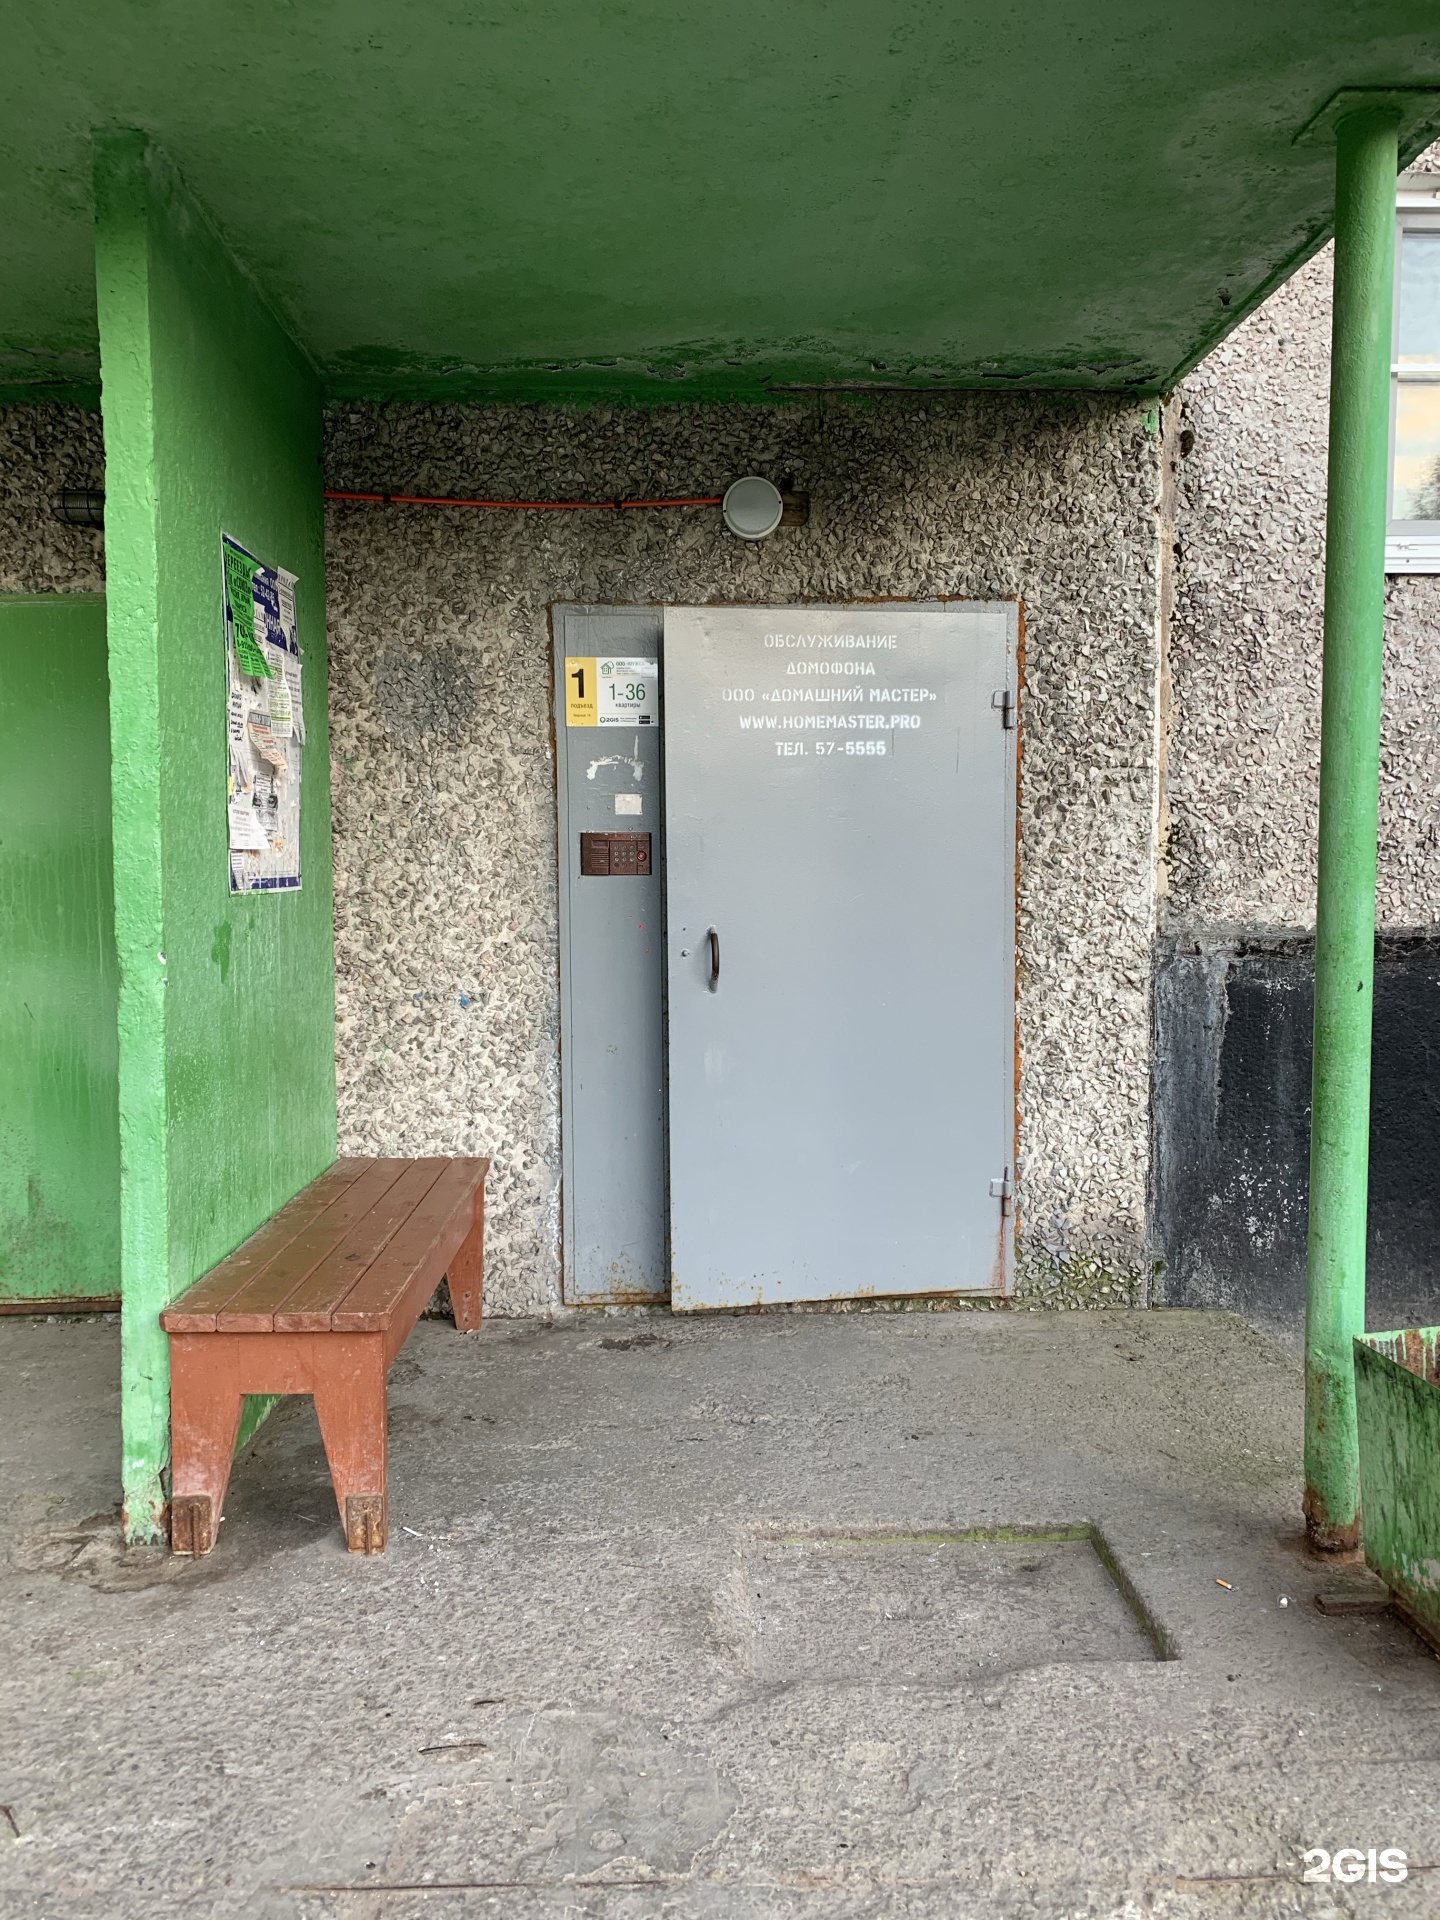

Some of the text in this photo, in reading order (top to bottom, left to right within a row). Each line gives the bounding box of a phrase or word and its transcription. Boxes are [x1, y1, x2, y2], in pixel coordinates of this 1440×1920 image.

[764, 634, 898, 649] ОБСЛУЖИВАНИЕ
[786, 661, 876, 676] ДОМОФОНА
[572, 669, 584, 698] 1
[609, 683, 646, 701] 1-36
[722, 685, 937, 702] ООО «ДОМАШНИЙ МАСТЕР»
[739, 715, 921, 729] WWW.HOMEMASTER.PRO
[775, 741, 887, 756] ТЕЛ. 57-5555
